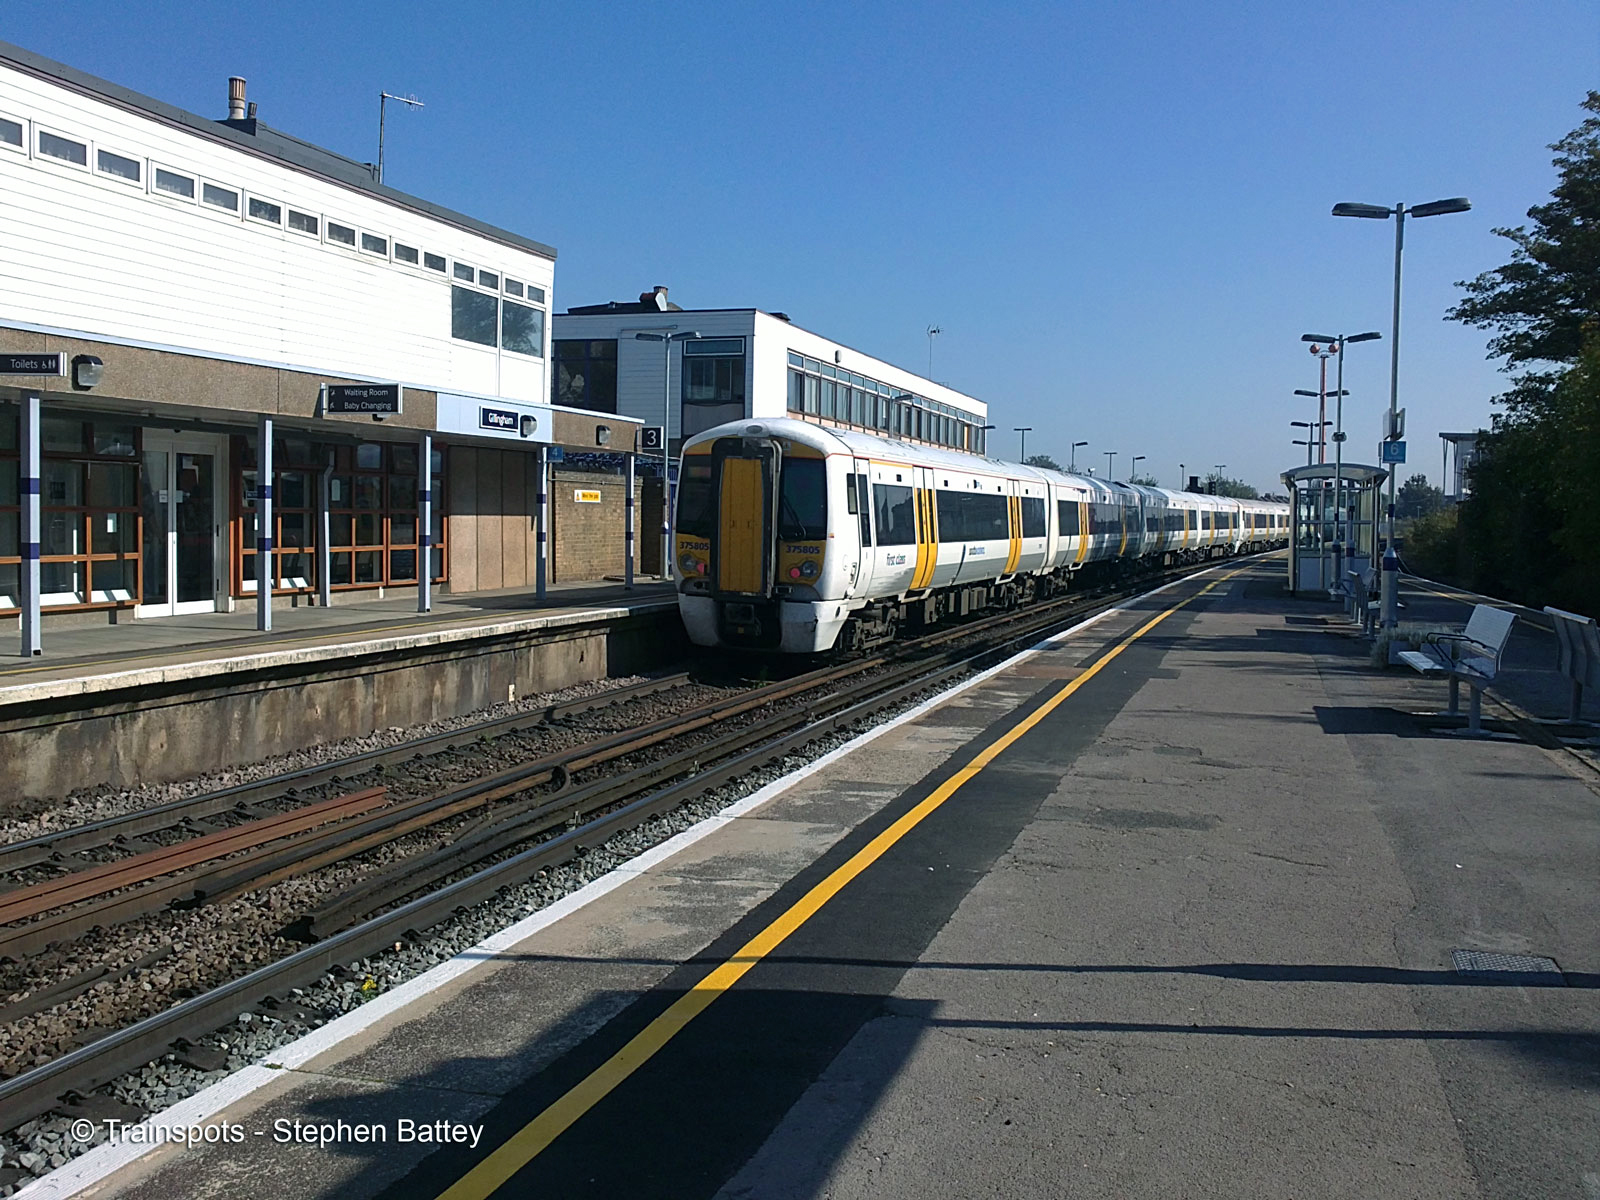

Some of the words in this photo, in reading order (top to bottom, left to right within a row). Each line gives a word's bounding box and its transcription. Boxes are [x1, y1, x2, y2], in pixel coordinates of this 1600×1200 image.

[10, 358, 38, 369] Toilets
[344, 388, 368, 398] Waiting
[369, 388, 388, 396] Room
[344, 401, 360, 411] Baby
[361, 401, 392, 411] Changing
[647, 430, 657, 446] 3
[551, 447, 558, 457] 4
[1390, 443, 1399, 455] 6
[679, 541, 710, 551] 375805
[785, 544, 820, 555] 375805
[886, 553, 896, 566] first
[895, 554, 906, 565] class
